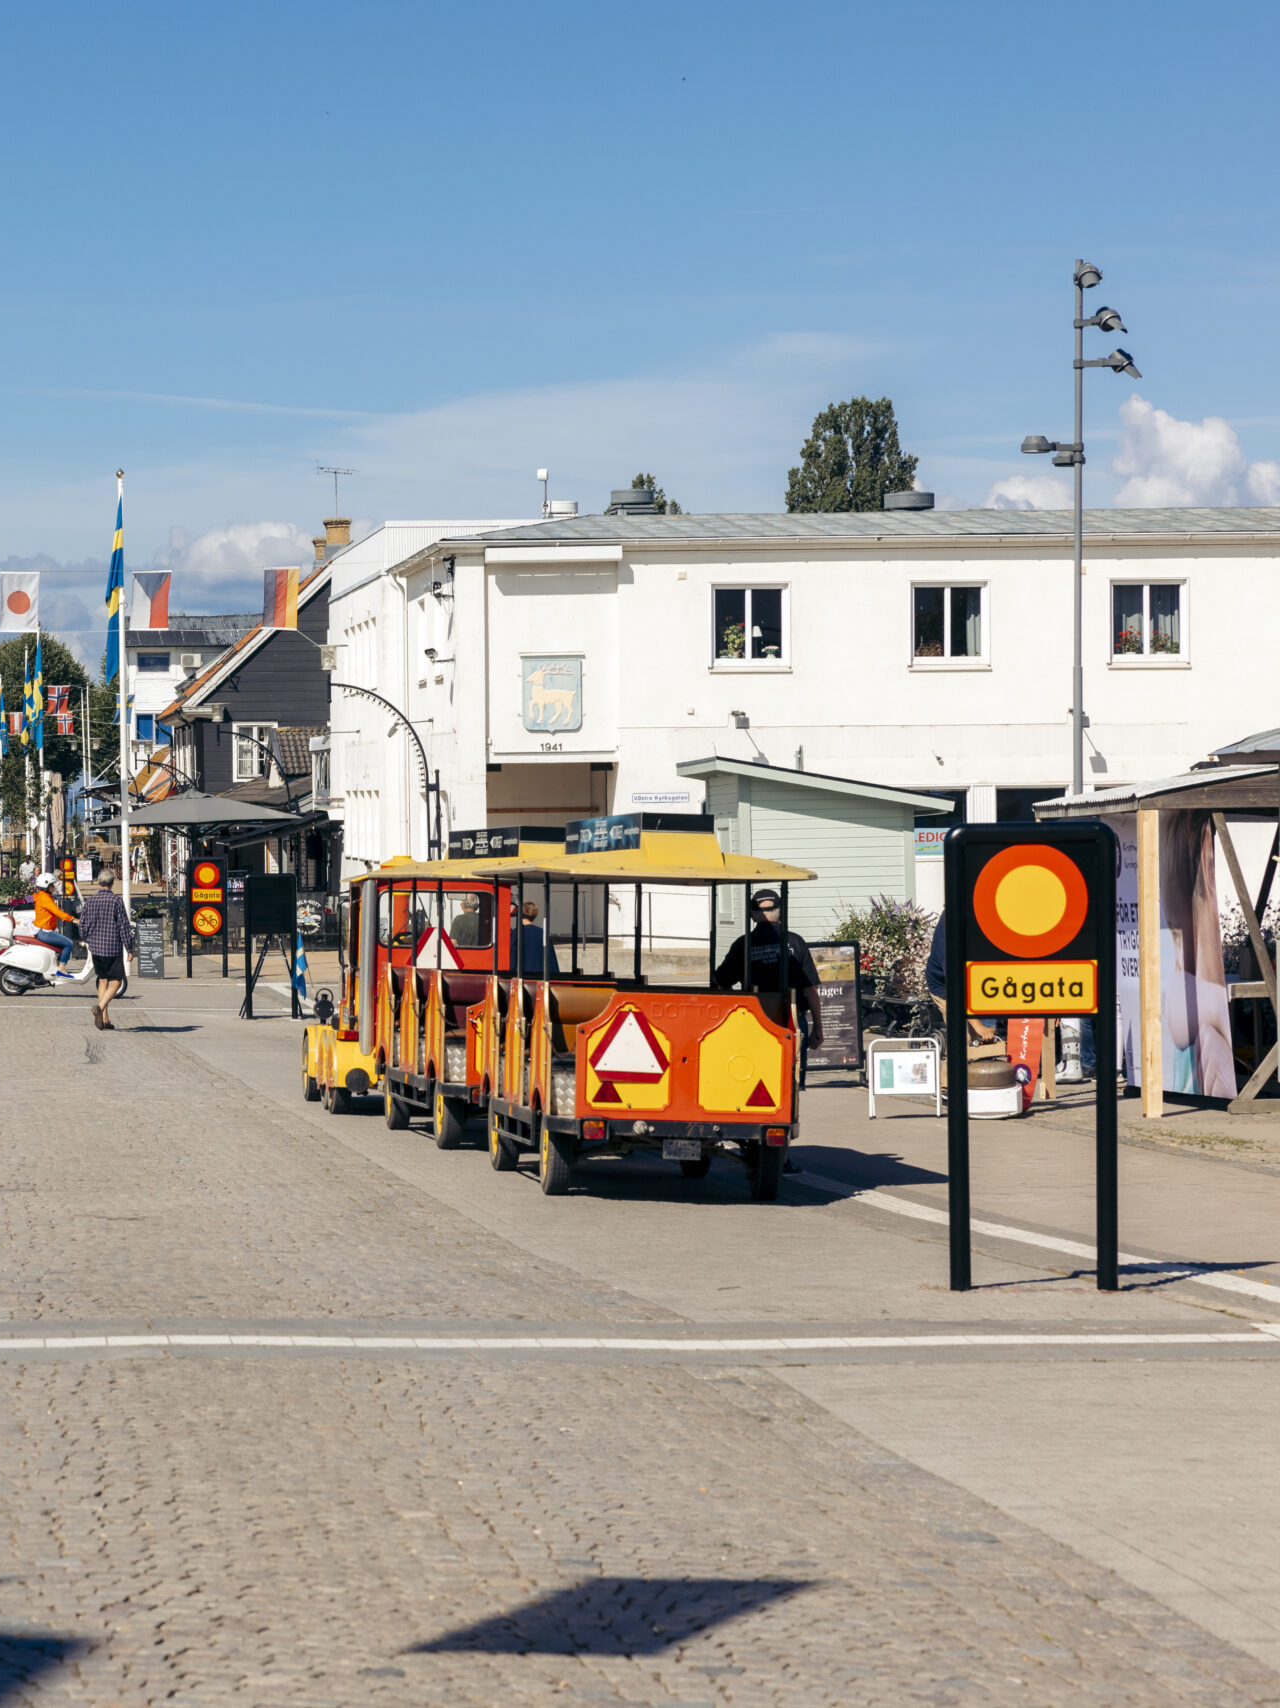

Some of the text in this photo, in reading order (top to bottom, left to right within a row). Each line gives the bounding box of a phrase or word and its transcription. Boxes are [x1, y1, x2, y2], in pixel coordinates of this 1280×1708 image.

[540, 743, 563, 751] 1941
[193, 891, 221, 899] Gågata
[1121, 958, 1139, 977] SVER
[981, 977, 1083, 1003] Gågata
[652, 1002, 720, 1019] DOTTO
[1019, 1025, 1029, 1060] Kristna
